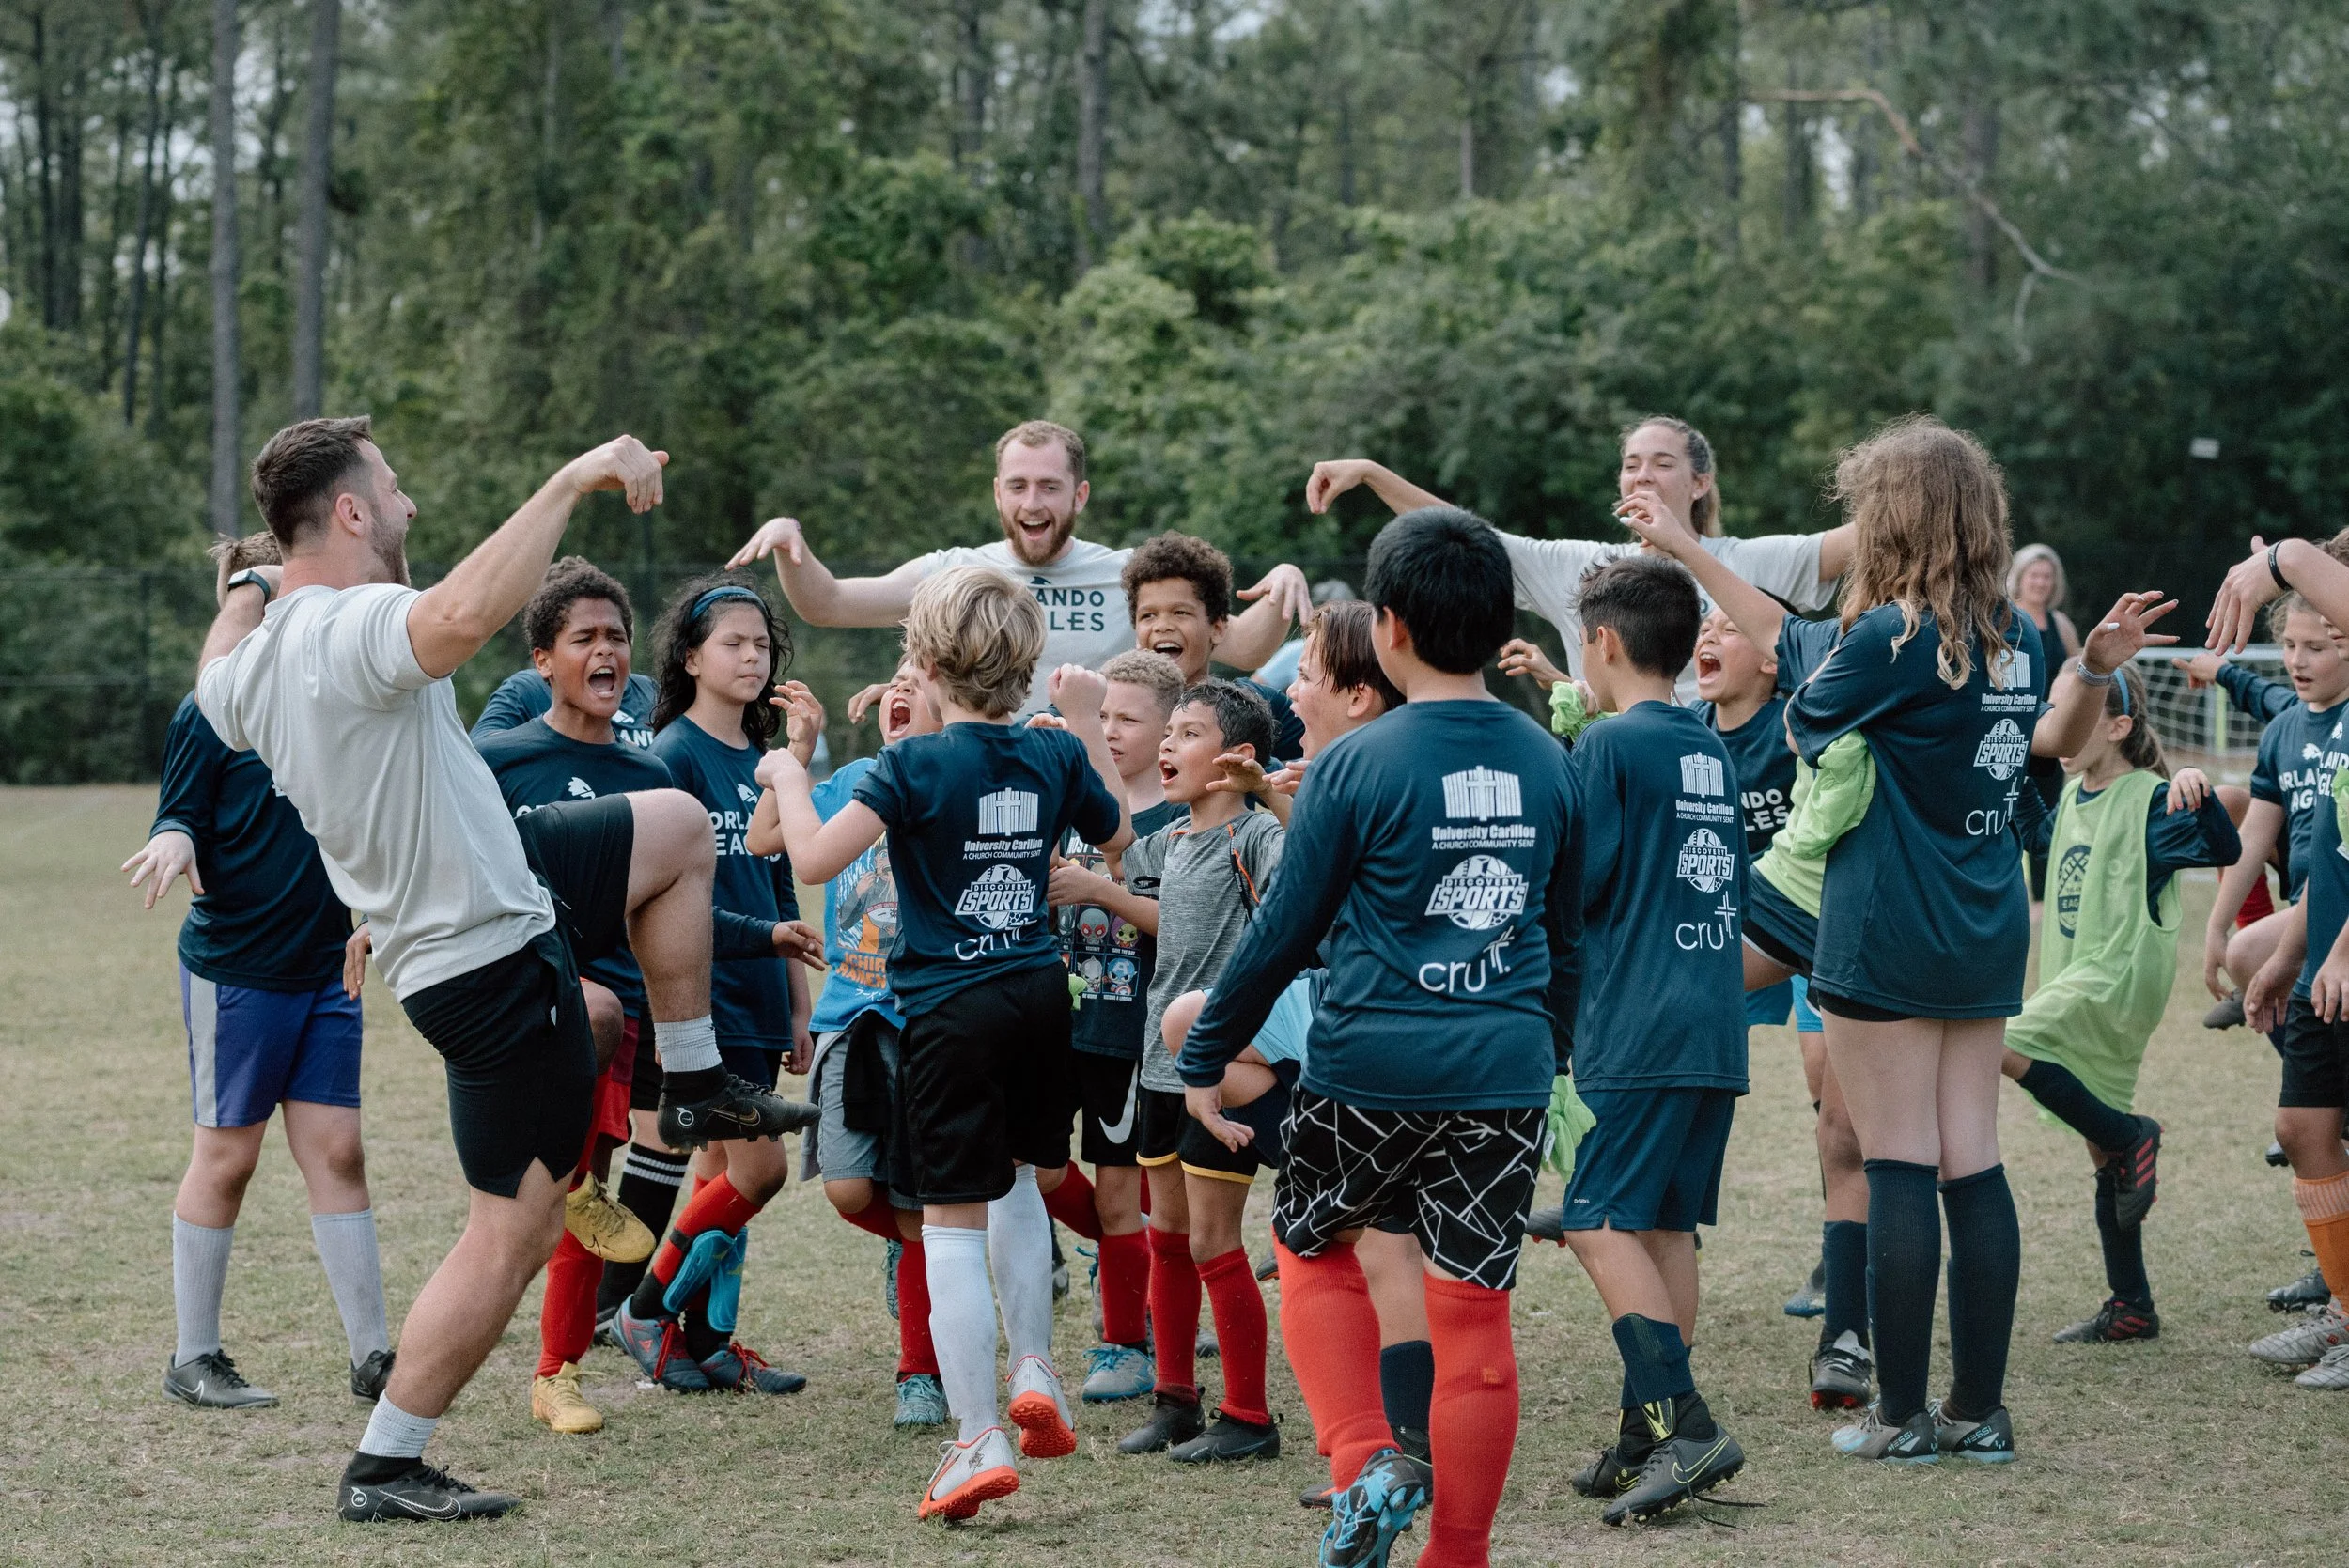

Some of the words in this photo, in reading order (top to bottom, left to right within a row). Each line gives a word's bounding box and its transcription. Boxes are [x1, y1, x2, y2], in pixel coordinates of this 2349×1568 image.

[1036, 588, 1105, 608] ANDO
[1050, 611, 1105, 632] LES
[1982, 693, 2013, 706] University
[1979, 743, 2026, 763] SPORTS
[1675, 799, 1706, 815] University
[1432, 826, 1488, 841] University
[1489, 824, 1536, 839] Carillon
[964, 840, 1011, 852] University
[1439, 841, 1468, 849] CHURCH
[1469, 839, 1517, 849] COMMUNITY
[1517, 839, 1536, 847] SENT
[1684, 846, 1725, 856] DISCOVERY
[1680, 853, 1731, 877] SPORTS
[974, 883, 1027, 892] DISCOVERY
[1446, 877, 1517, 887] DISCOVERY
[962, 889, 1032, 911] SPORTS
[1434, 885, 1524, 910] SPORTS
[1675, 922, 1724, 950] cru
[1419, 959, 1486, 994] cru
